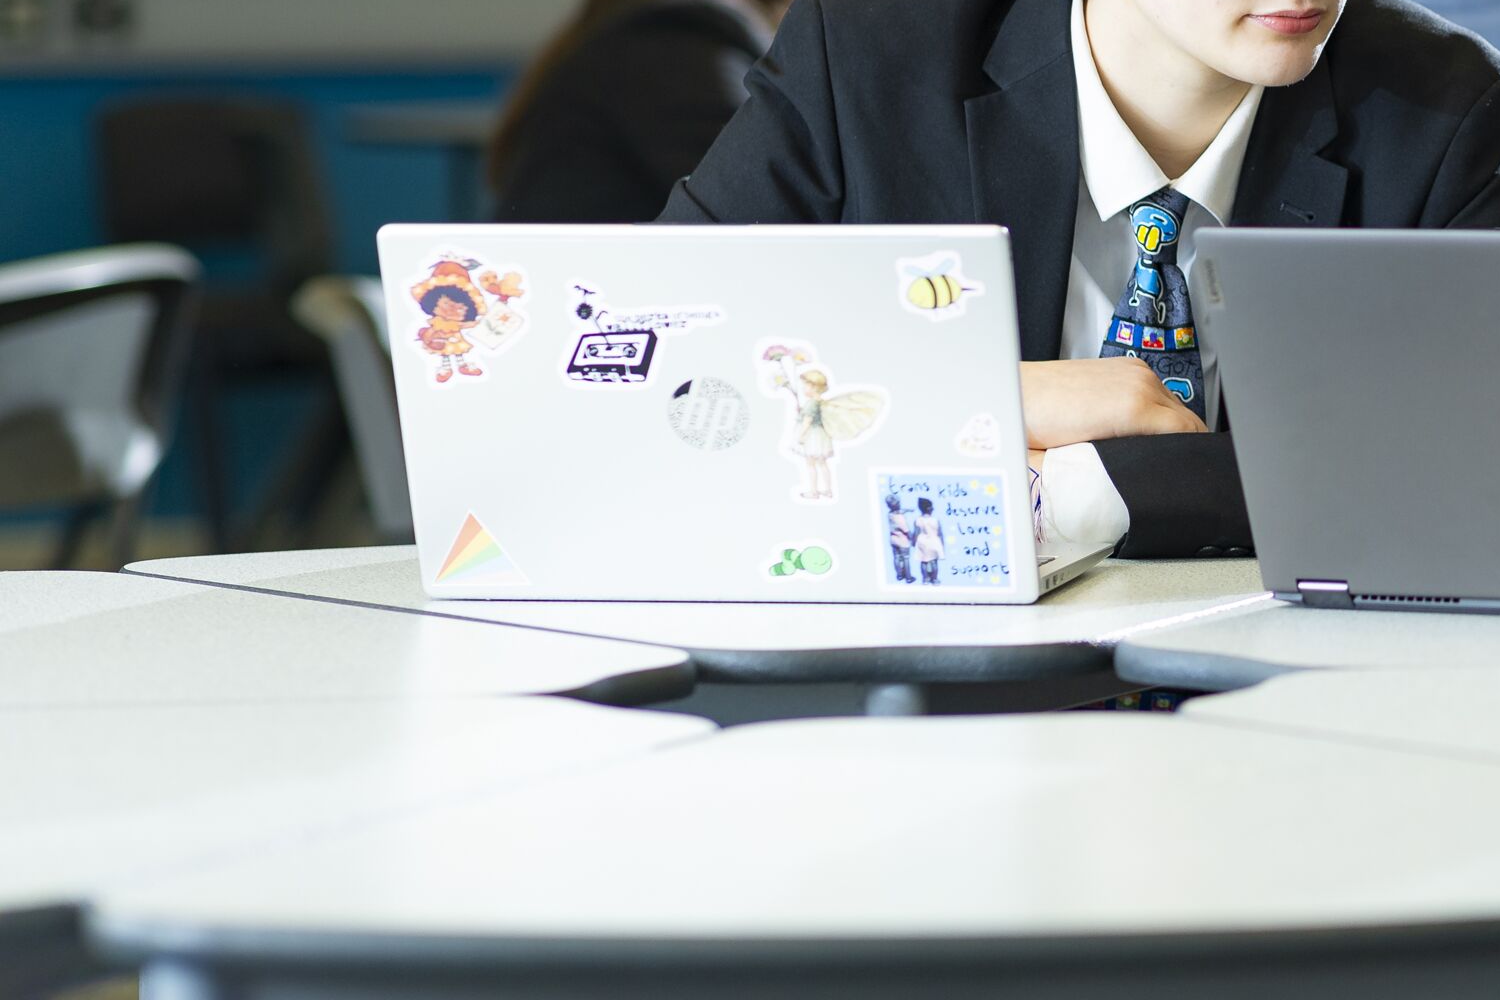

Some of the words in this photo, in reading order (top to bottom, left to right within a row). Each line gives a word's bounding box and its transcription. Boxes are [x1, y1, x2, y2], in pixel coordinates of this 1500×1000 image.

[889, 476, 930, 495] trans
[938, 482, 968, 498] kids
[945, 502, 1000, 517] deserve
[963, 541, 990, 556] and
[951, 561, 1010, 578] support
